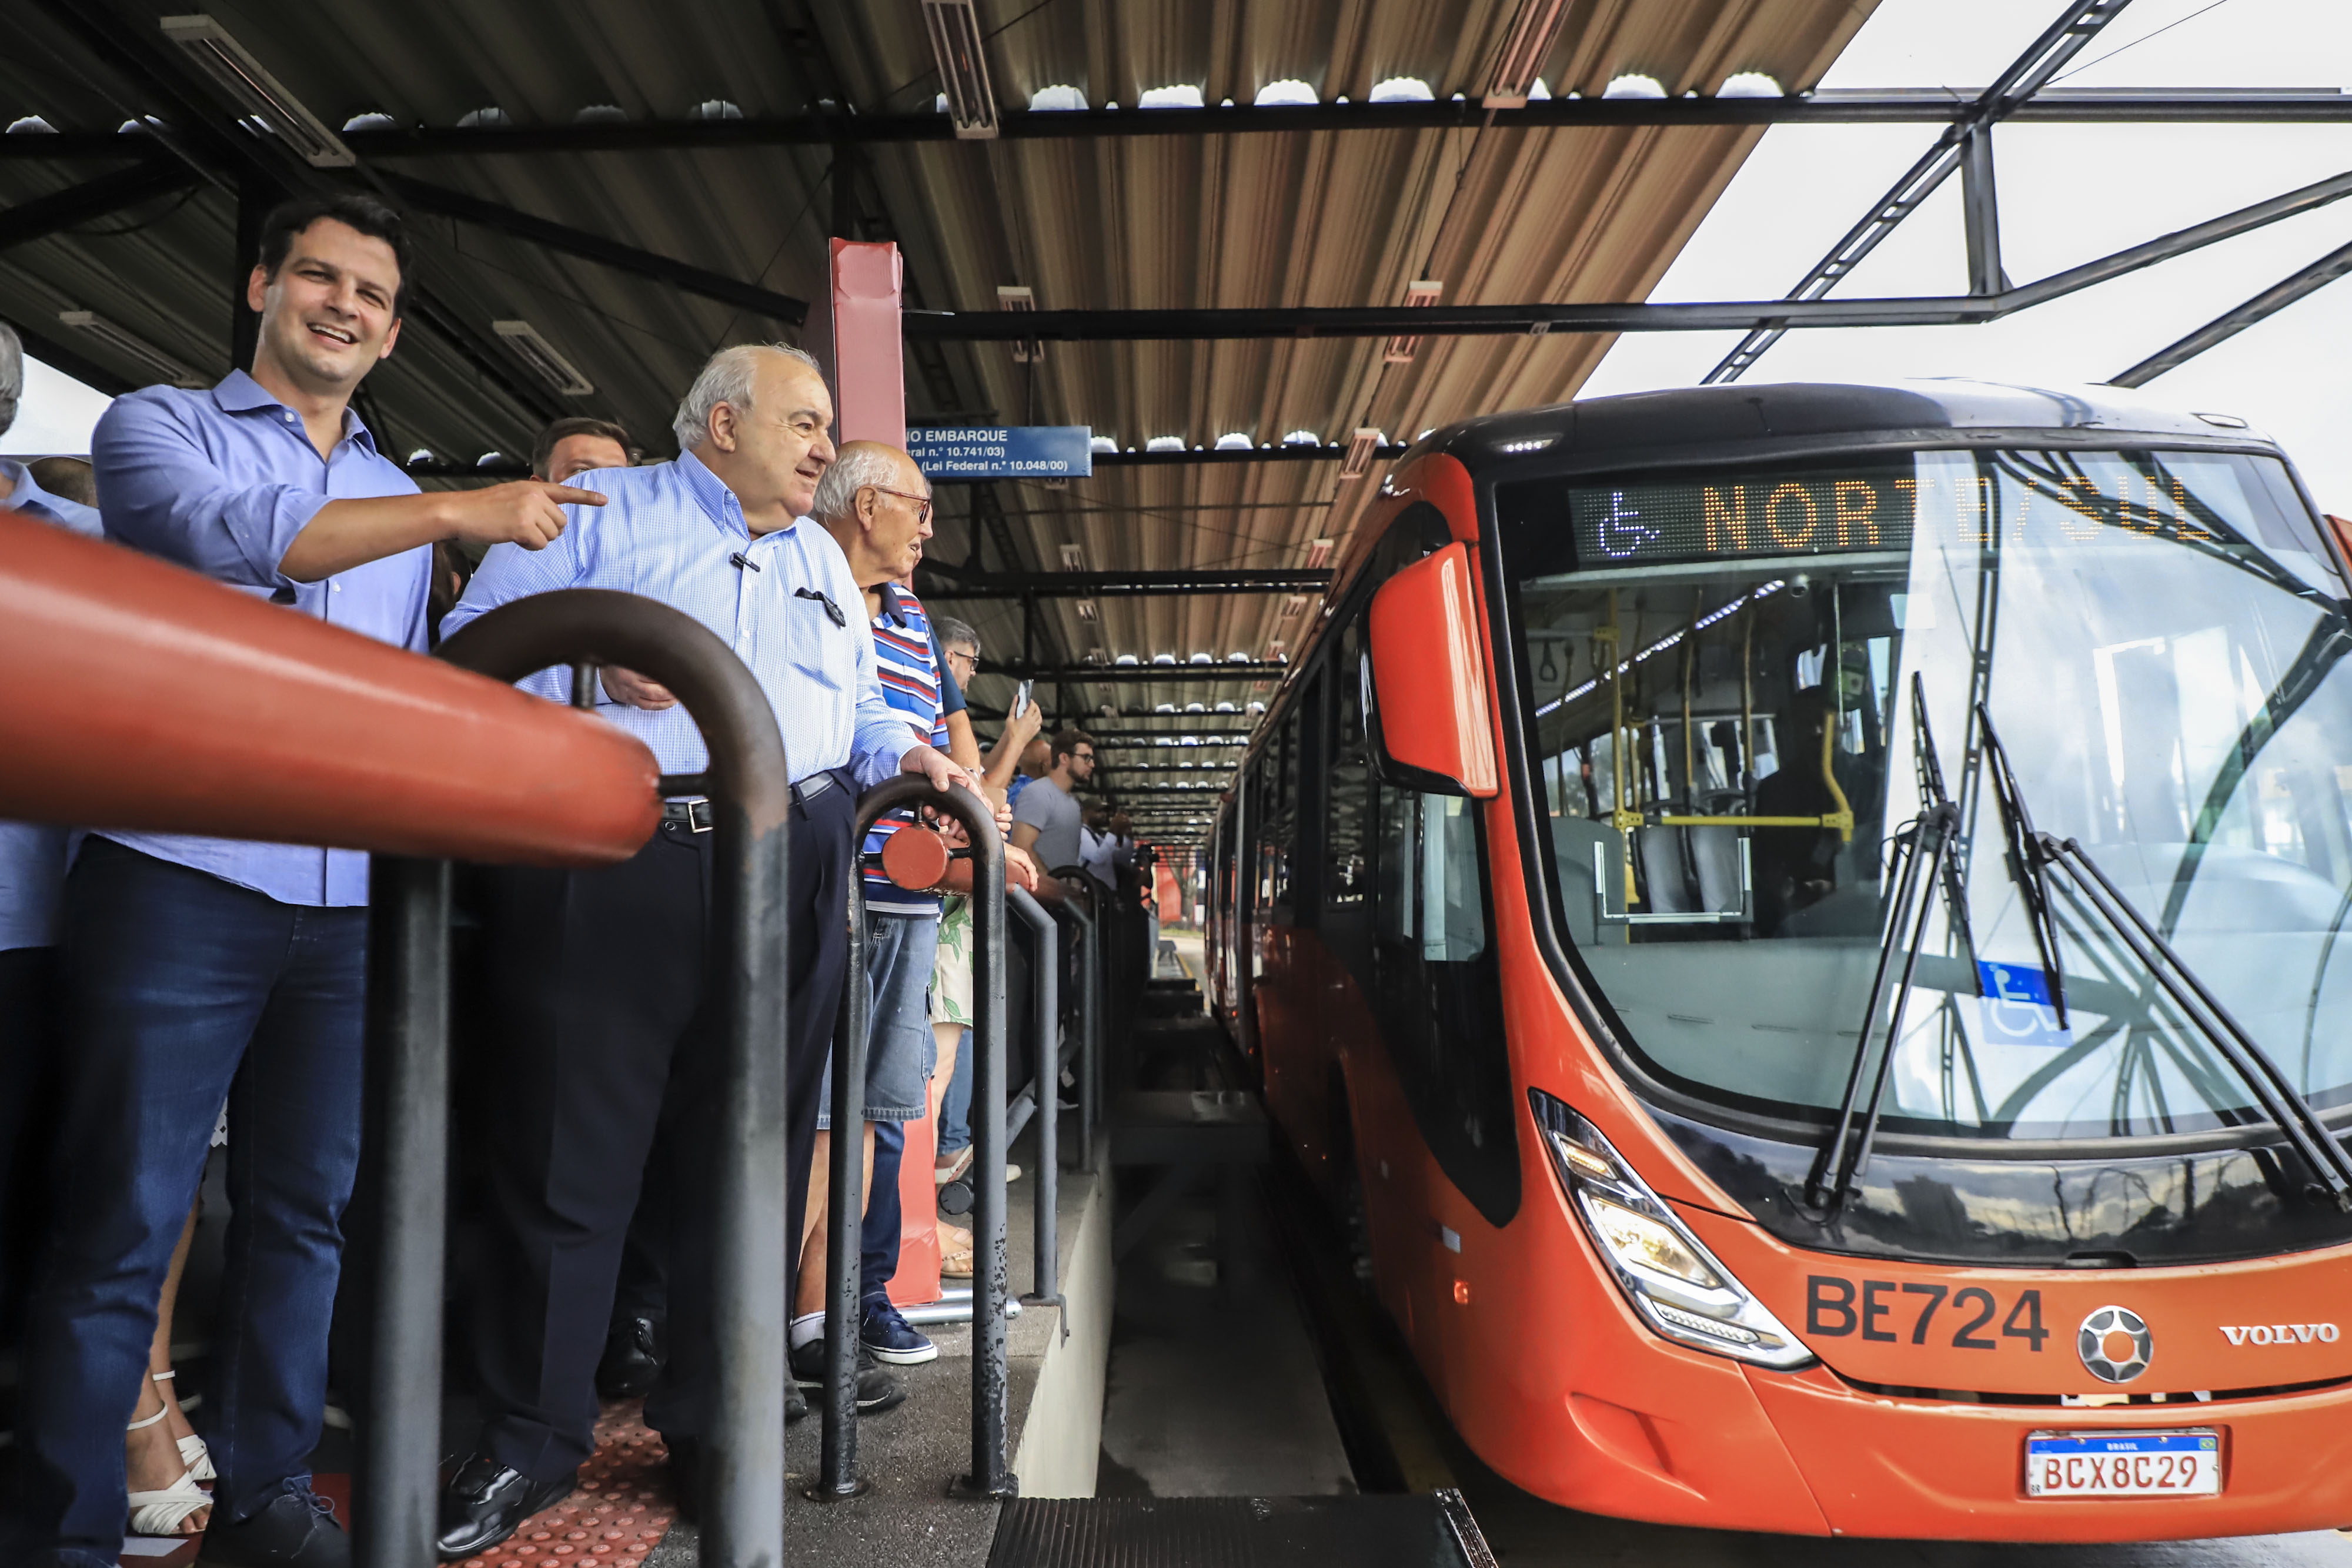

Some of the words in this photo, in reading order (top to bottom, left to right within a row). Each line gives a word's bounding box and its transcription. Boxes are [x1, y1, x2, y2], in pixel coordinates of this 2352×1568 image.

[926, 430, 1008, 442] EMBARQUE
[947, 447, 1005, 458] 10.741/03)
[921, 461, 943, 473] (Lei
[946, 461, 988, 470] Federal
[1010, 460, 1068, 472] 10.048/00)
[1806, 1275, 2049, 1352] BE724
[2219, 1323, 2340, 1345] VOLVO
[2044, 1456, 2197, 1489] BCX8C29
